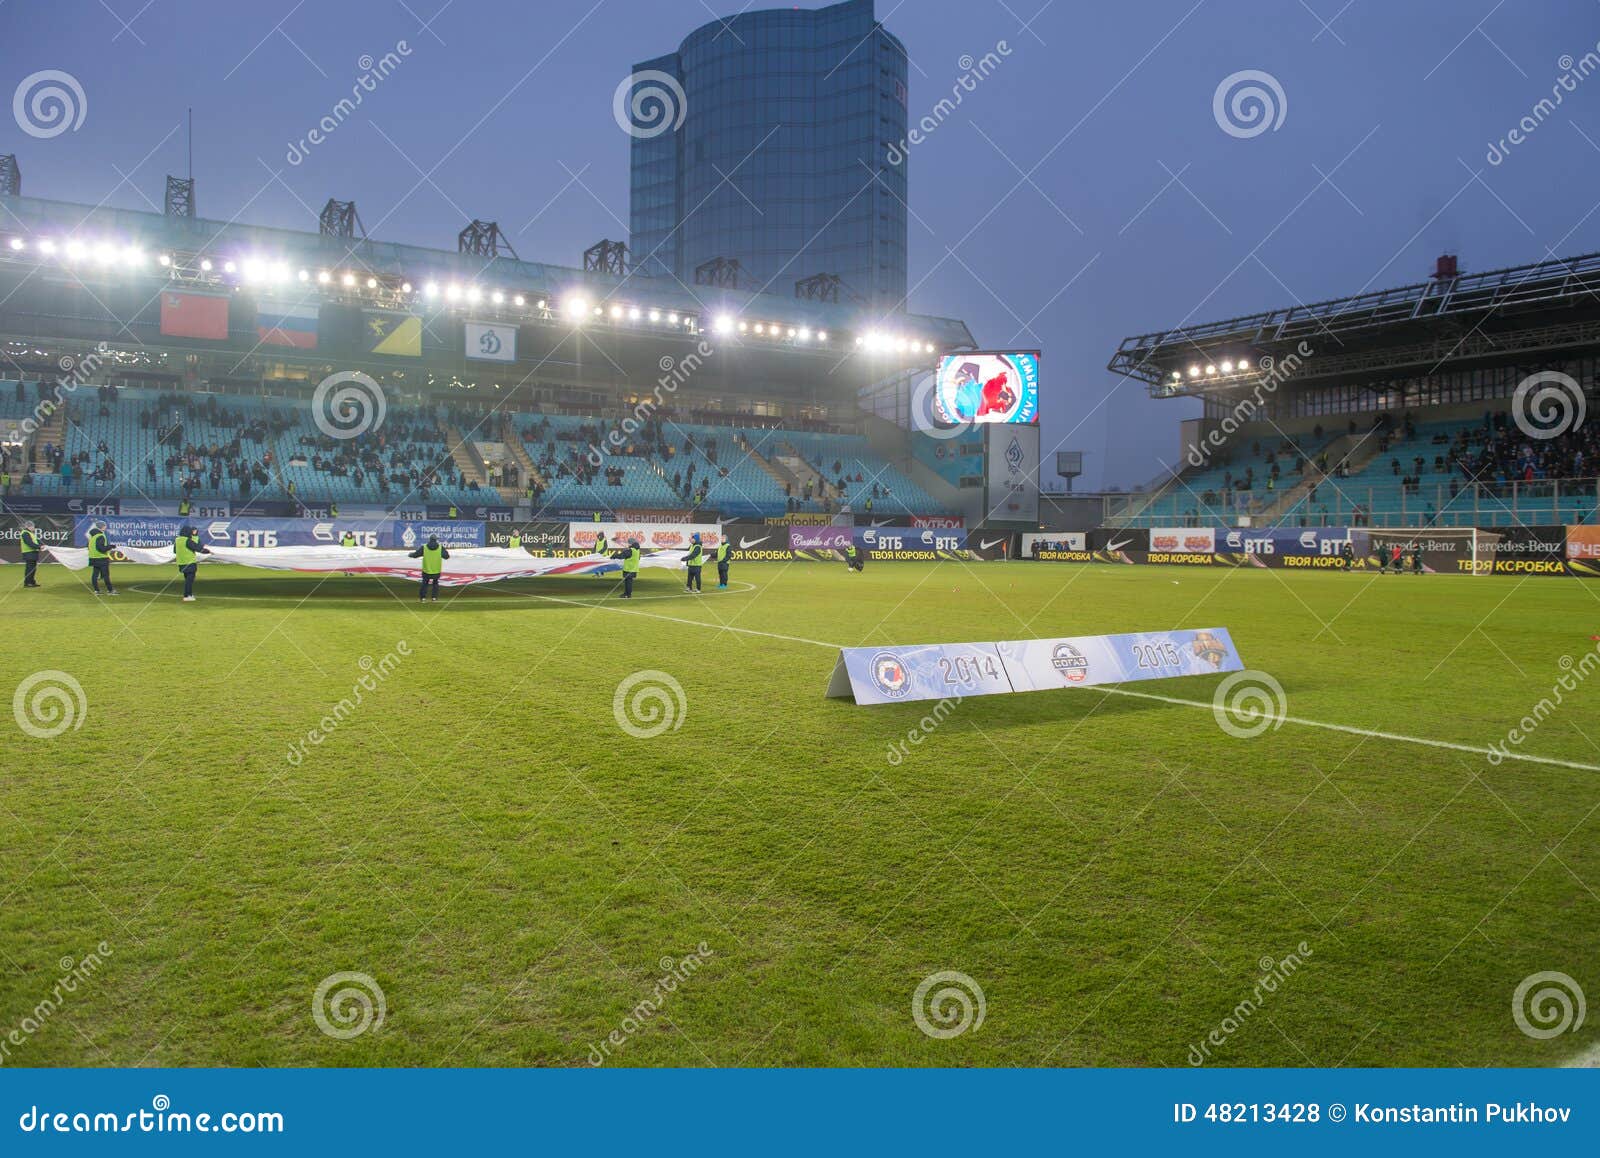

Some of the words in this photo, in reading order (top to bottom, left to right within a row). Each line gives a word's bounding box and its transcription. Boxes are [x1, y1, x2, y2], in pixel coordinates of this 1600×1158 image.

[86, 505, 114, 515] ВТБ
[199, 506, 226, 517] ВТБ
[303, 509, 328, 519] ВТБ
[401, 511, 423, 520] ВТБ
[490, 512, 511, 521] ВТБ
[236, 530, 278, 547] ВТБ
[878, 536, 902, 550] ВТБ
[935, 536, 958, 550] ВТБ
[1244, 539, 1274, 554] ВТБ
[745, 550, 793, 560] КОРОБКА
[870, 551, 894, 560] ТВОЯ
[896, 551, 936, 560] КОРОБКА
[1039, 551, 1057, 560] ТВОЯ
[1058, 551, 1091, 561] КОРОБКА
[1147, 553, 1170, 563] ТВОЯ
[1170, 554, 1212, 564] КОРОБКА
[1283, 556, 1311, 566] ТВОЯ
[1312, 556, 1365, 568] КОРОКА
[1457, 559, 1493, 571] ТВОЯ
[1132, 643, 1180, 668] 2015
[939, 655, 999, 684] 2014
